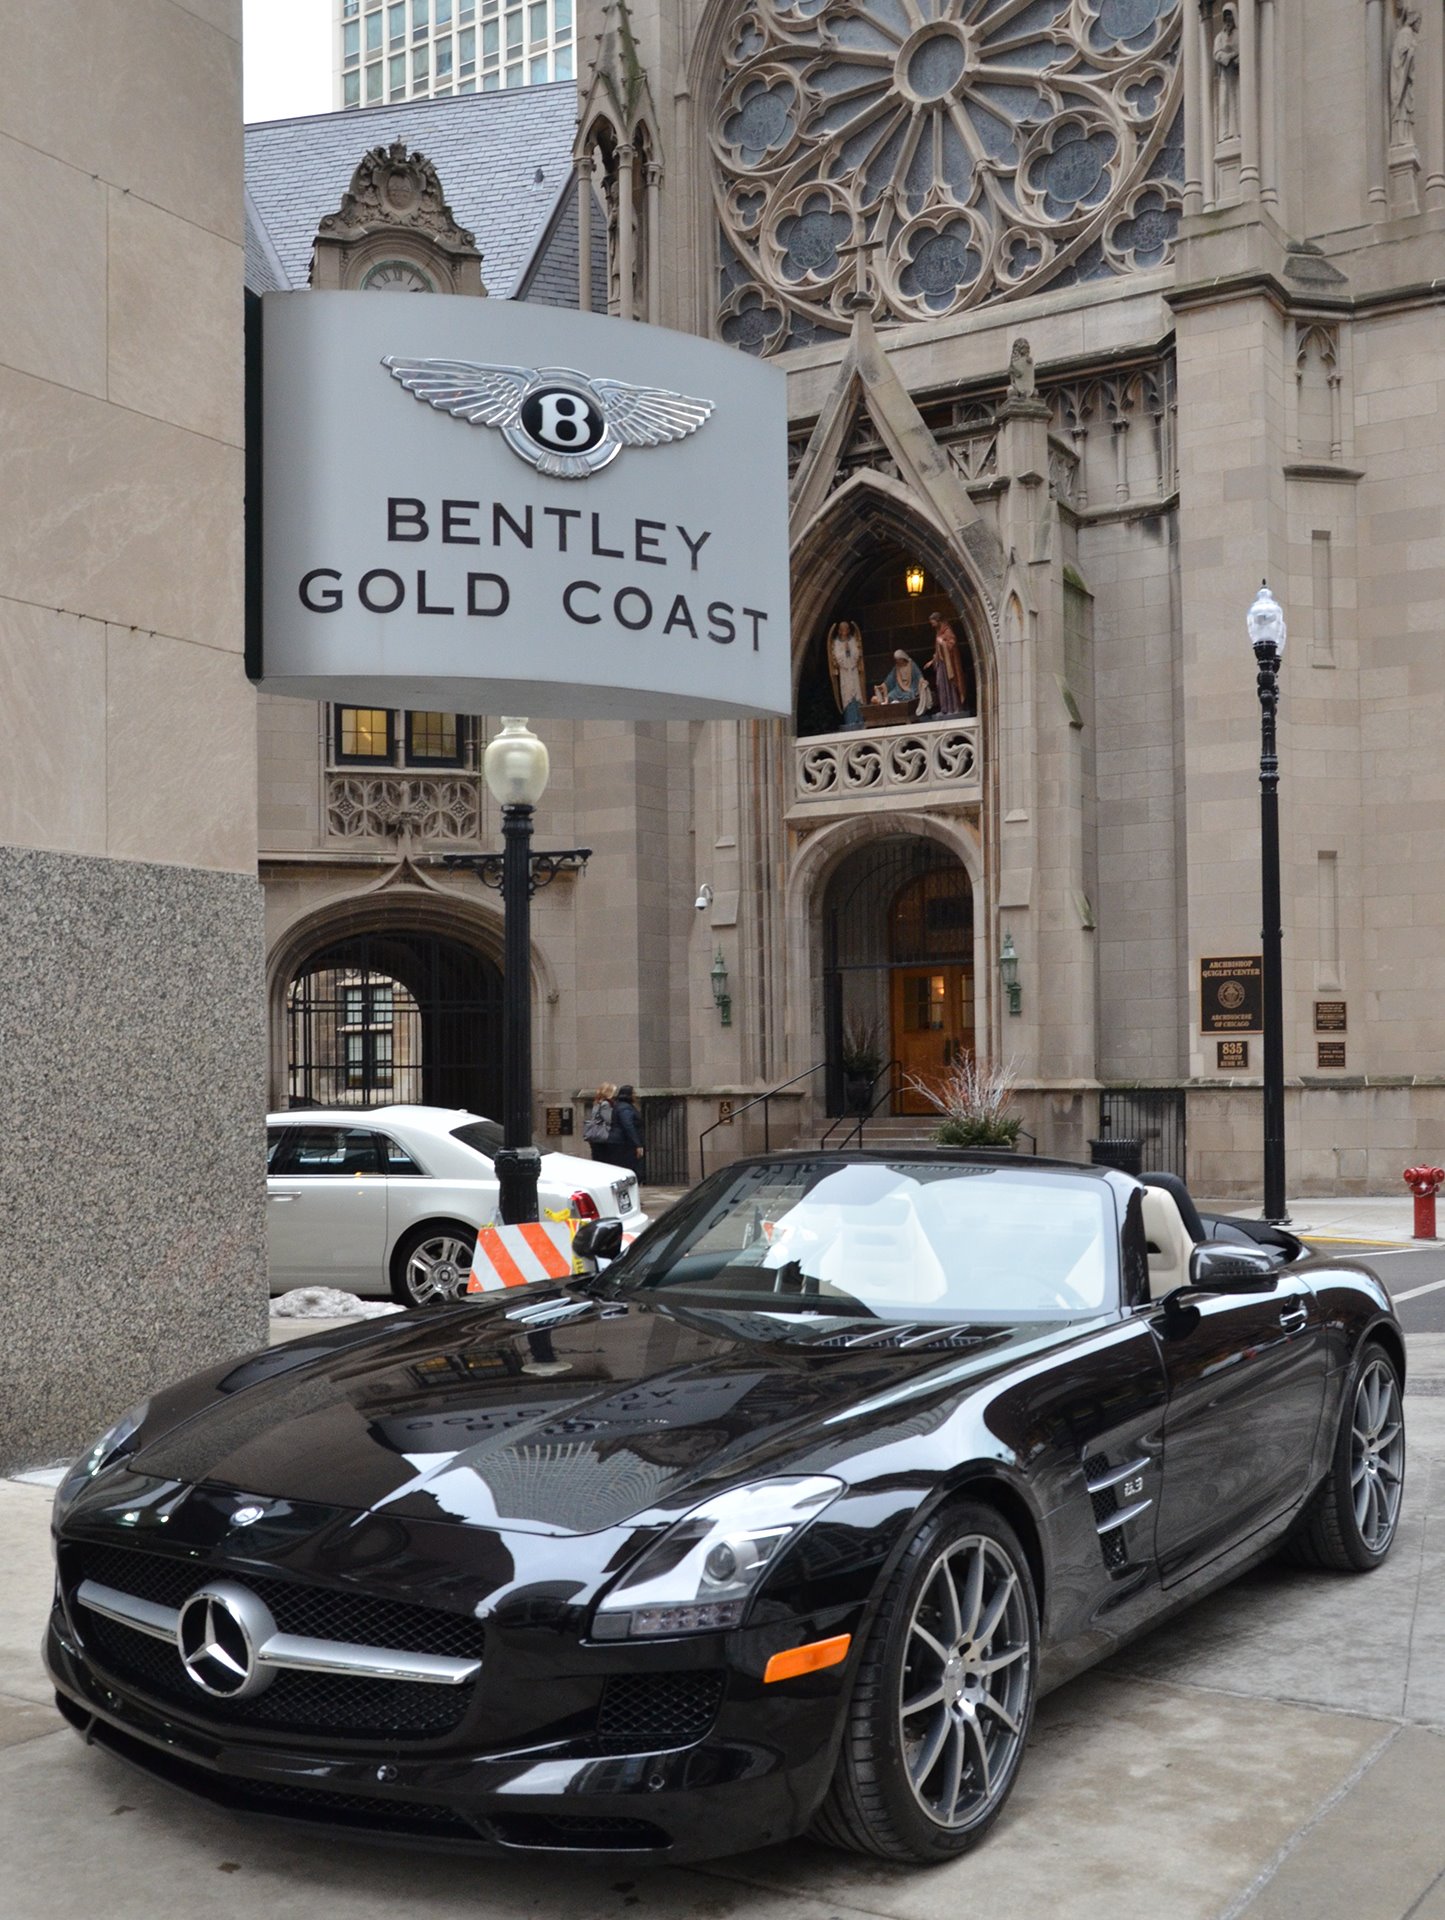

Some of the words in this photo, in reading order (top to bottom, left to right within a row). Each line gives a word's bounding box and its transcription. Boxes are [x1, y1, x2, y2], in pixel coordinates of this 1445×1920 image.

[538, 392, 592, 447] B
[387, 497, 711, 571] BENTLEY
[298, 568, 510, 617] GOLD
[562, 580, 769, 652] COAST
[1209, 960, 1253, 968] ARCHBISHOP
[1232, 968, 1260, 976] CENTER
[1223, 1020, 1249, 1028] CHICAGO
[1222, 1042, 1243, 1055] 835
